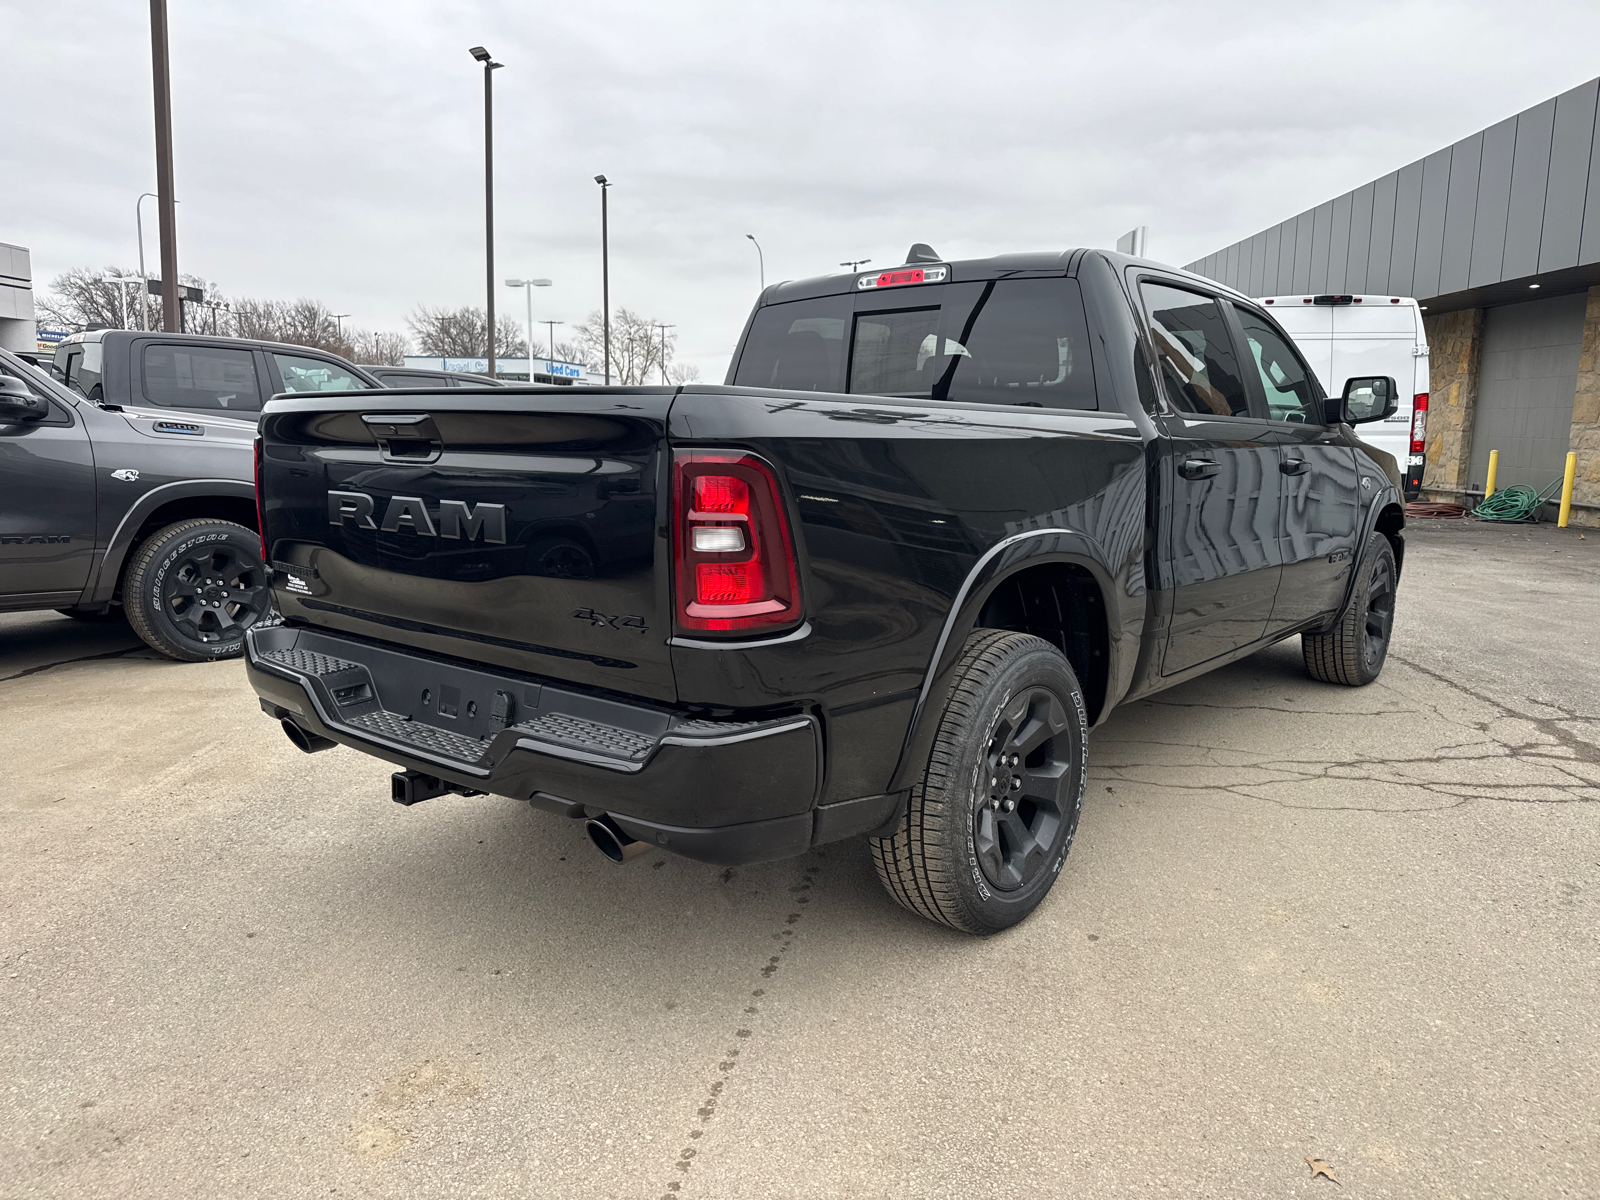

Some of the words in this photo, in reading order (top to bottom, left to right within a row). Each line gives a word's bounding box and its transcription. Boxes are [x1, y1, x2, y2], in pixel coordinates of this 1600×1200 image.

[440, 360, 470, 371] Used
[475, 360, 504, 372] Cas
[546, 362, 564, 375] Used
[564, 365, 580, 377] Cars
[328, 490, 507, 545] RAM
[1, 535, 71, 544] RAM
[152, 533, 229, 611] BRIDGESTONE
[1070, 690, 1088, 812] DUELER
